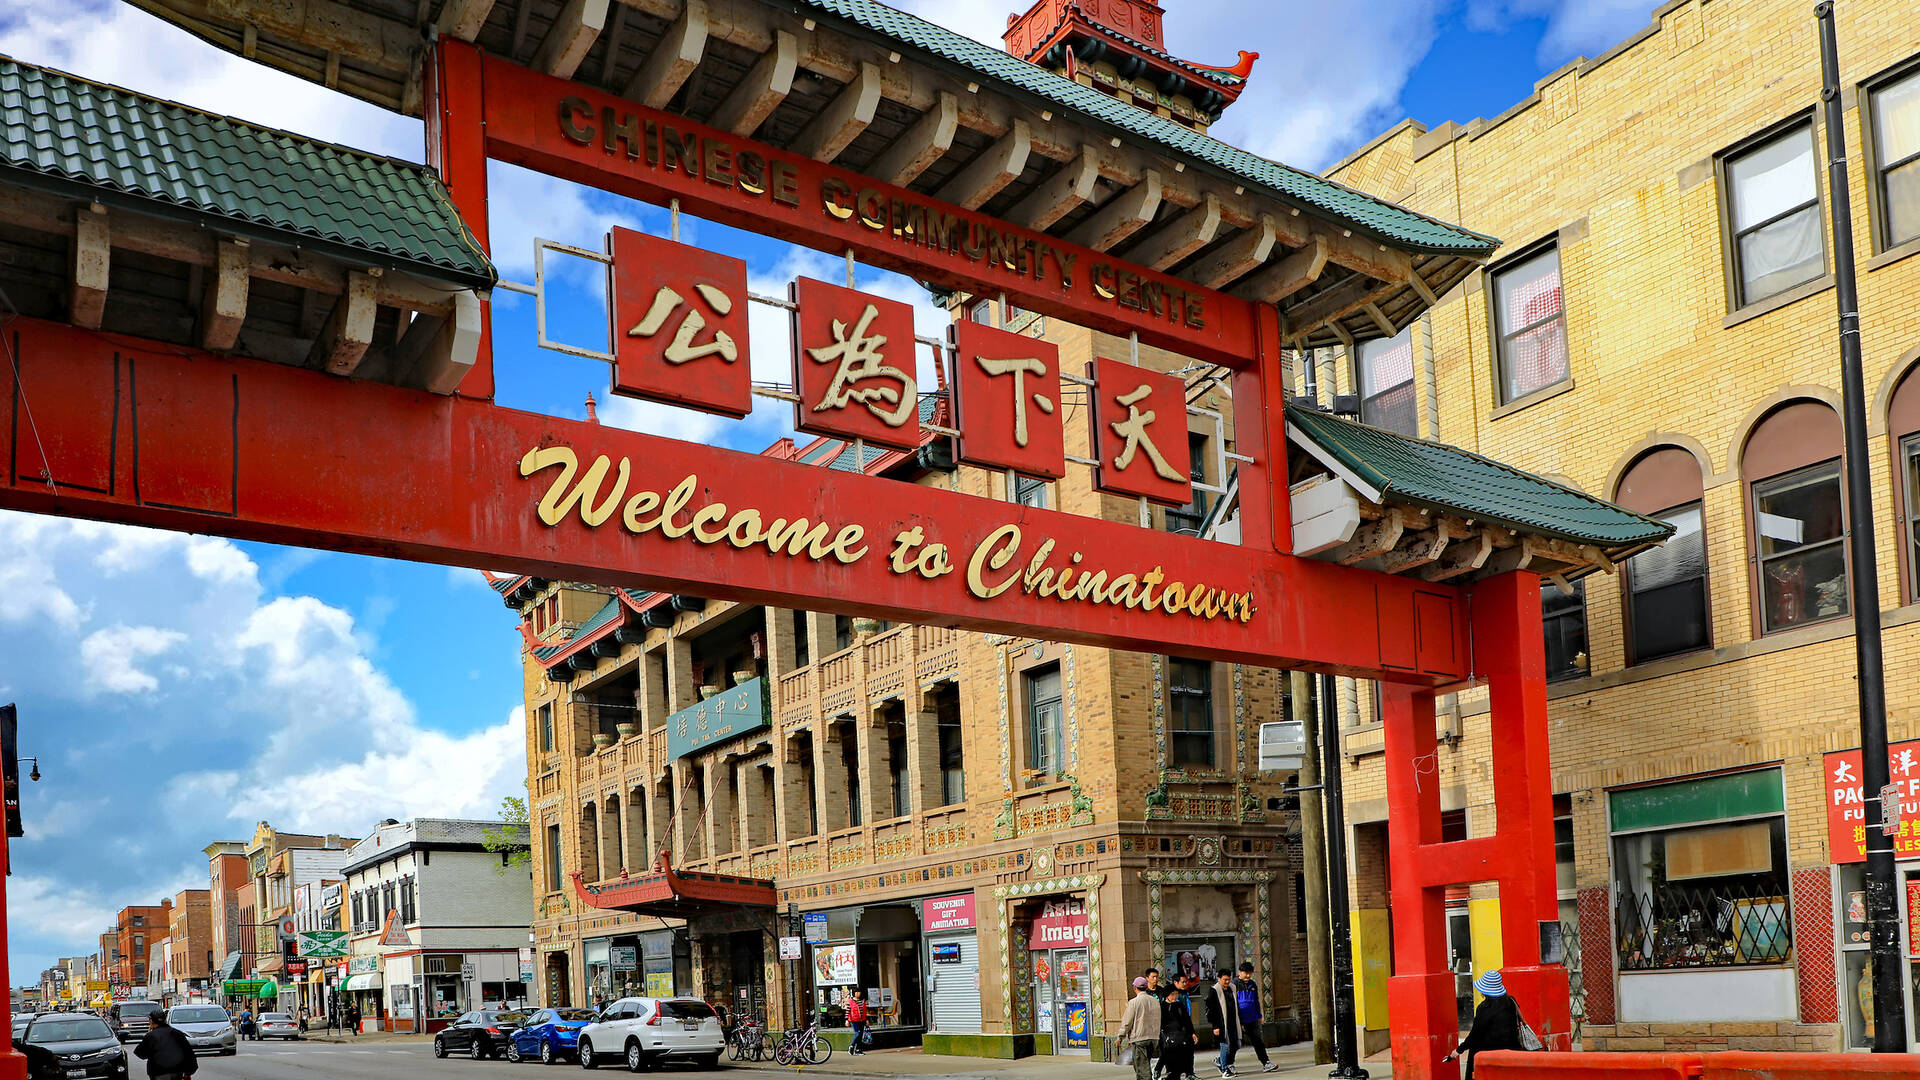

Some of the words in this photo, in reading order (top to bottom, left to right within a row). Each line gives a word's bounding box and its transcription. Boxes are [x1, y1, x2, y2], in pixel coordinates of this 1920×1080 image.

[559, 95, 801, 208] CHINESE
[821, 176, 1078, 289] COMMUNITY
[1091, 261, 1206, 331] CENTE
[628, 284, 739, 365] 公
[975, 355, 1055, 448] 下
[1110, 383, 1189, 484] 天
[519, 446, 870, 564] Welcome
[888, 525, 955, 579] to
[965, 523, 1258, 624] Chinatown
[930, 918, 969, 929] ANIMATION
[932, 899, 966, 910] SOUVENIR
[941, 909, 957, 919] GIFT
